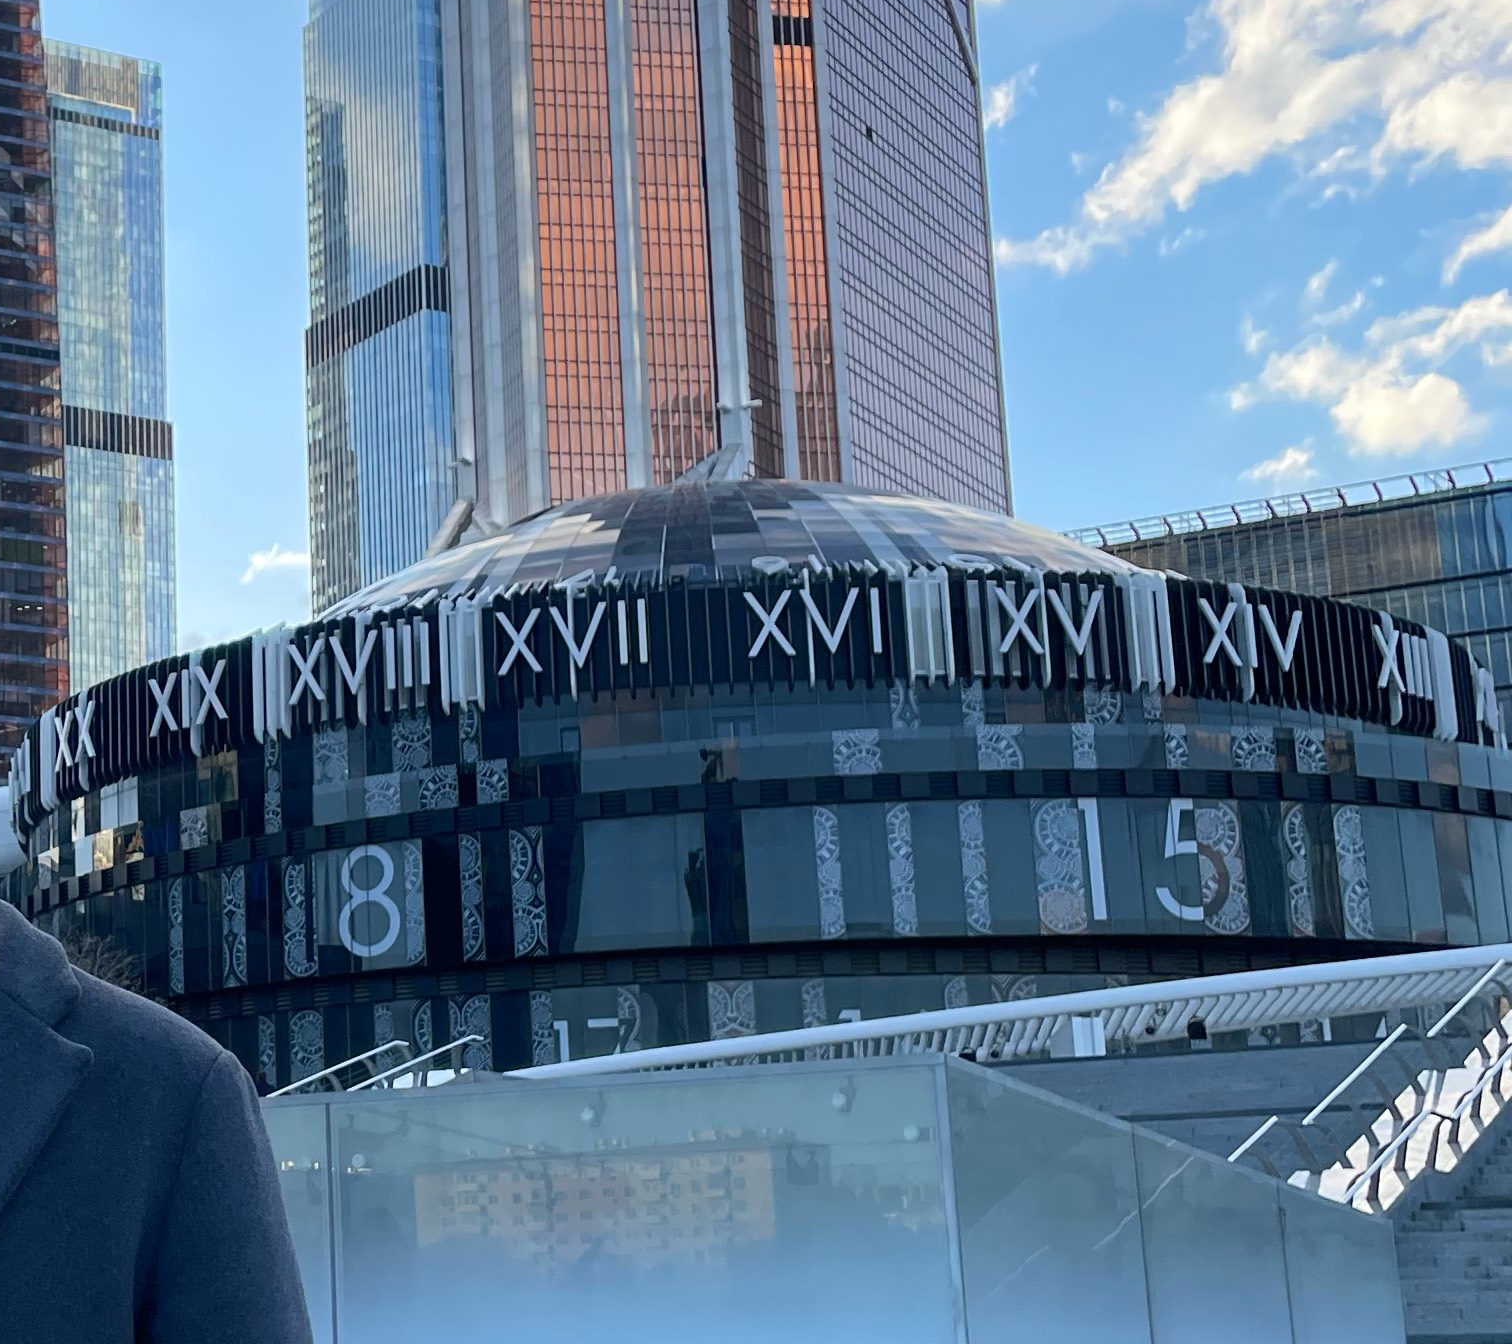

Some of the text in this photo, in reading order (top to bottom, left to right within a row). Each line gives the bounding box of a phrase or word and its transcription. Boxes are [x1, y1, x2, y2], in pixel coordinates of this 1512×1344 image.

[54, 699, 97, 773] XX
[148, 658, 229, 738] XIX
[289, 619, 430, 706] XVIII
[495, 599, 649, 676] XVII
[743, 587, 883, 658] XVI
[995, 587, 1104, 655] XV
[1199, 597, 1302, 672] XIV
[1373, 623, 1433, 701] XIII
[339, 844, 400, 956] 8
[1077, 797, 1230, 921] 15
